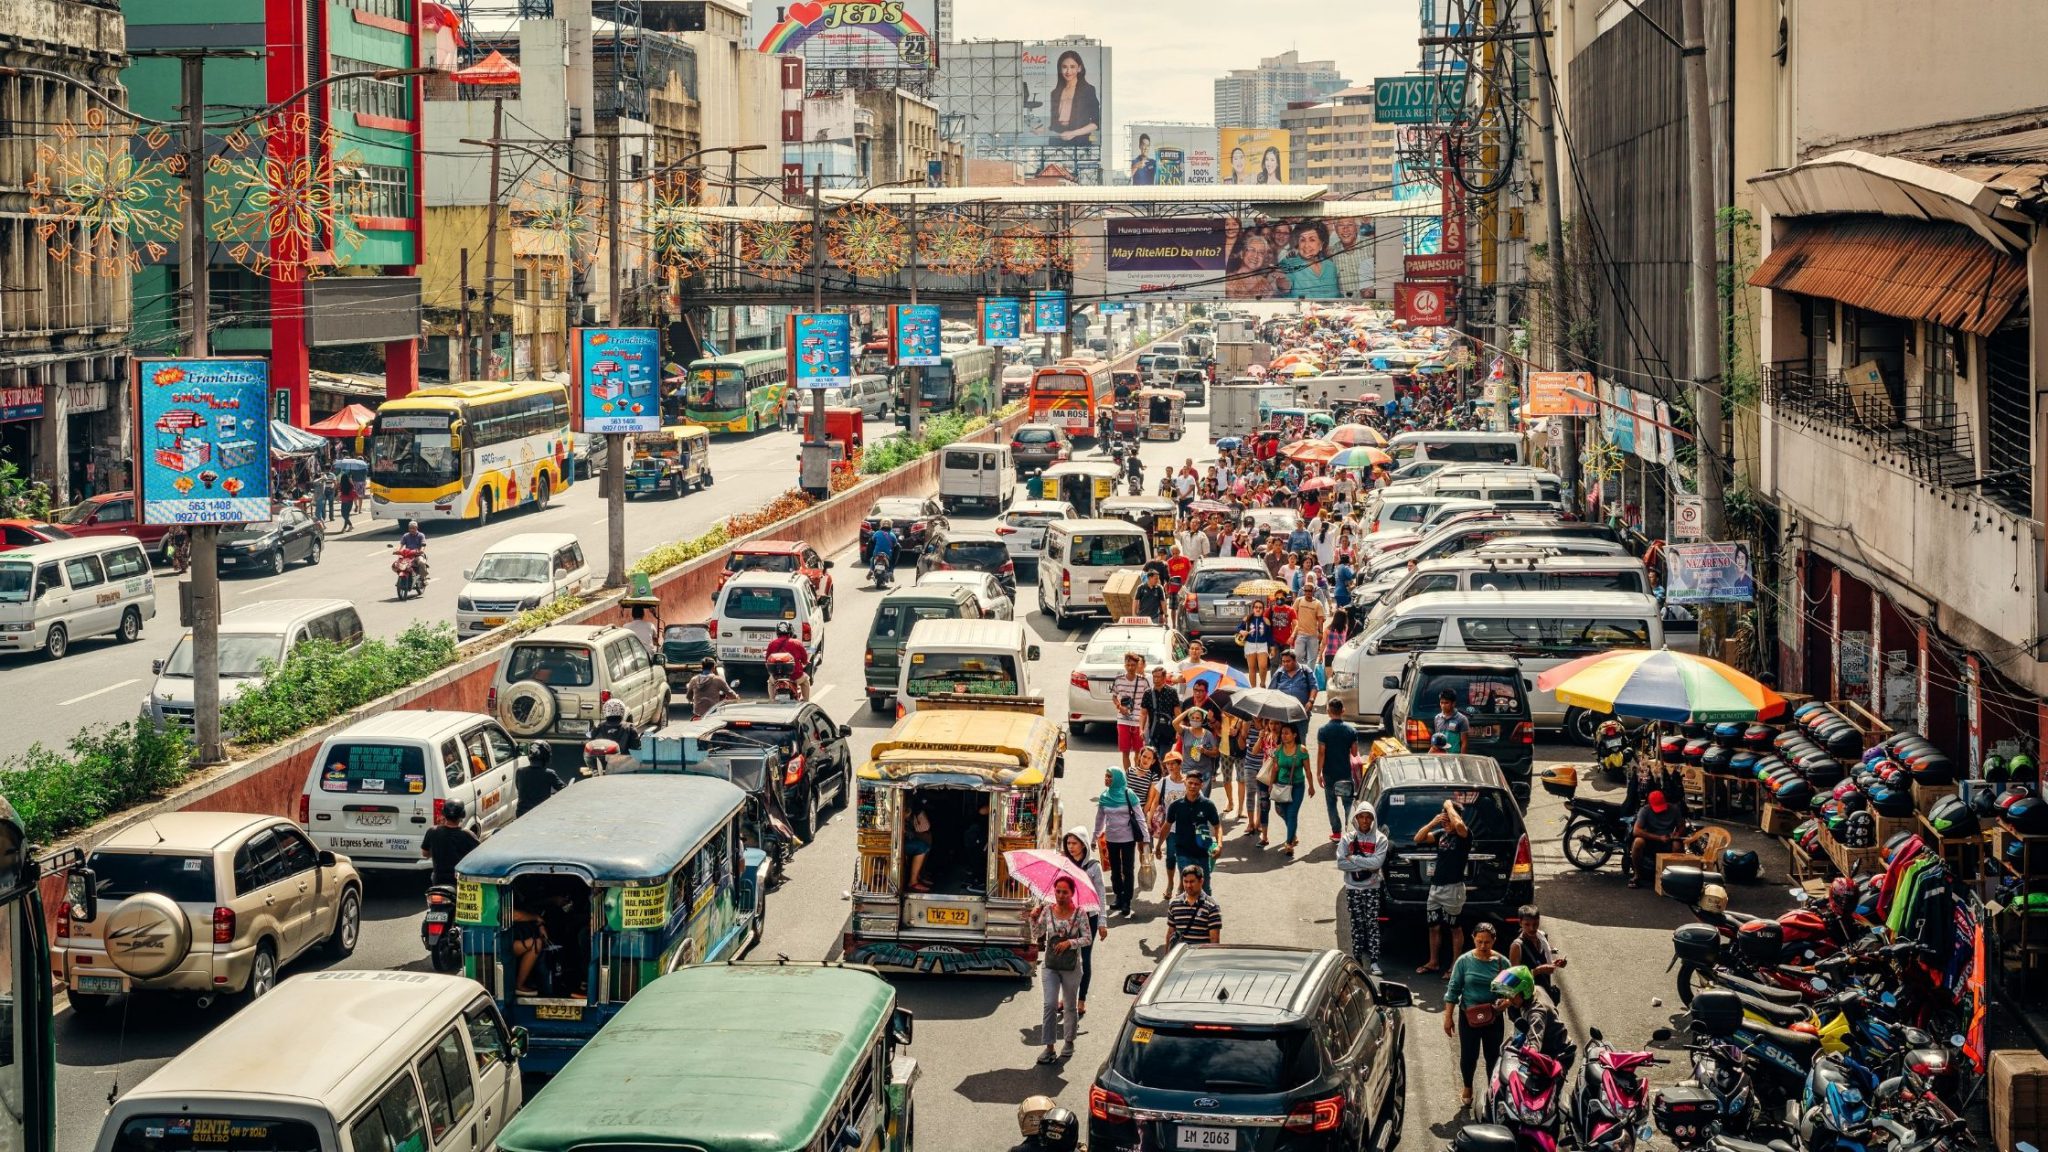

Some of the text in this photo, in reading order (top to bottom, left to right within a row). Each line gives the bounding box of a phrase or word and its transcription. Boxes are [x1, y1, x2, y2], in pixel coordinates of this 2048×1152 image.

[825, 1, 905, 29] JED'S
[904, 41, 927, 55] 24
[1379, 109, 1405, 118] HOTEL
[1112, 248, 1133, 260] May
[1181, 248, 1194, 257] ba
[1196, 247, 1222, 257] nito?
[1406, 260, 1464, 272] PAWNSHOP
[188, 372, 253, 384] Franchise
[8, 389, 21, 407] STOP
[209, 400, 240, 410] MAN
[1053, 410, 1087, 418] MA ROSE
[188, 502, 206, 510] 563
[175, 511, 242, 522] 0927 011 8000
[1686, 556, 1731, 569] NAZARENO
[959, 745, 997, 753] SPURS
[330, 837, 338, 847] UV
[340, 838, 362, 849] Express
[363, 838, 383, 848] Service
[625, 909, 638, 917] TEXT
[931, 910, 965, 921] TWZ 122
[193, 1120, 232, 1134] BENTE
[231, 1127, 240, 1136] ON
[192, 1134, 230, 1143] QUATRO
[1203, 1131, 1230, 1144] 2063
